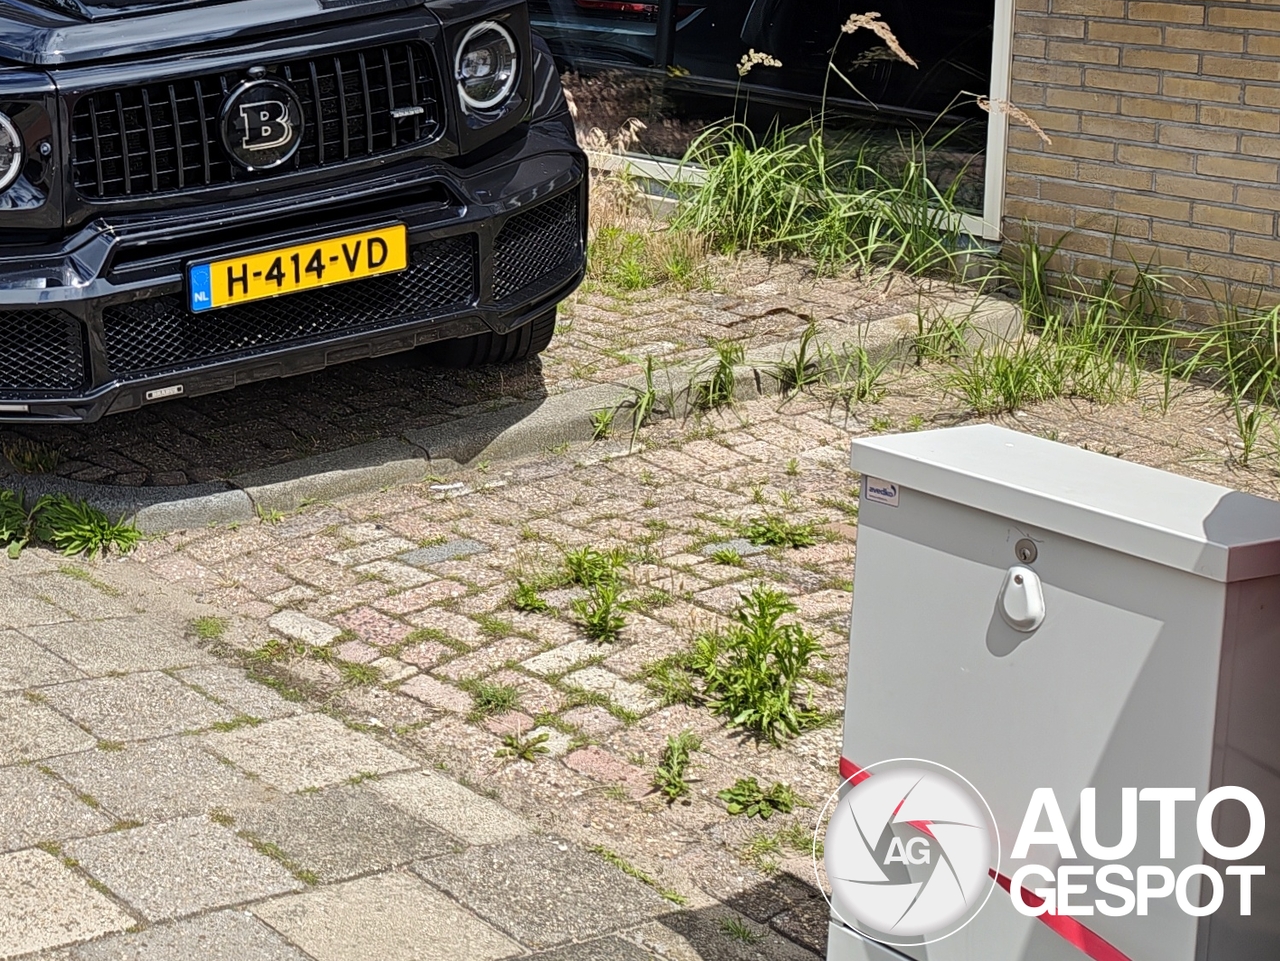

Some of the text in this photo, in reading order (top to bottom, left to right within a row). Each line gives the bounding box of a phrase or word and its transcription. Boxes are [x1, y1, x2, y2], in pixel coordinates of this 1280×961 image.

[239, 100, 293, 151] B
[227, 237, 388, 297] H-414-VD
[194, 291, 209, 302] NL
